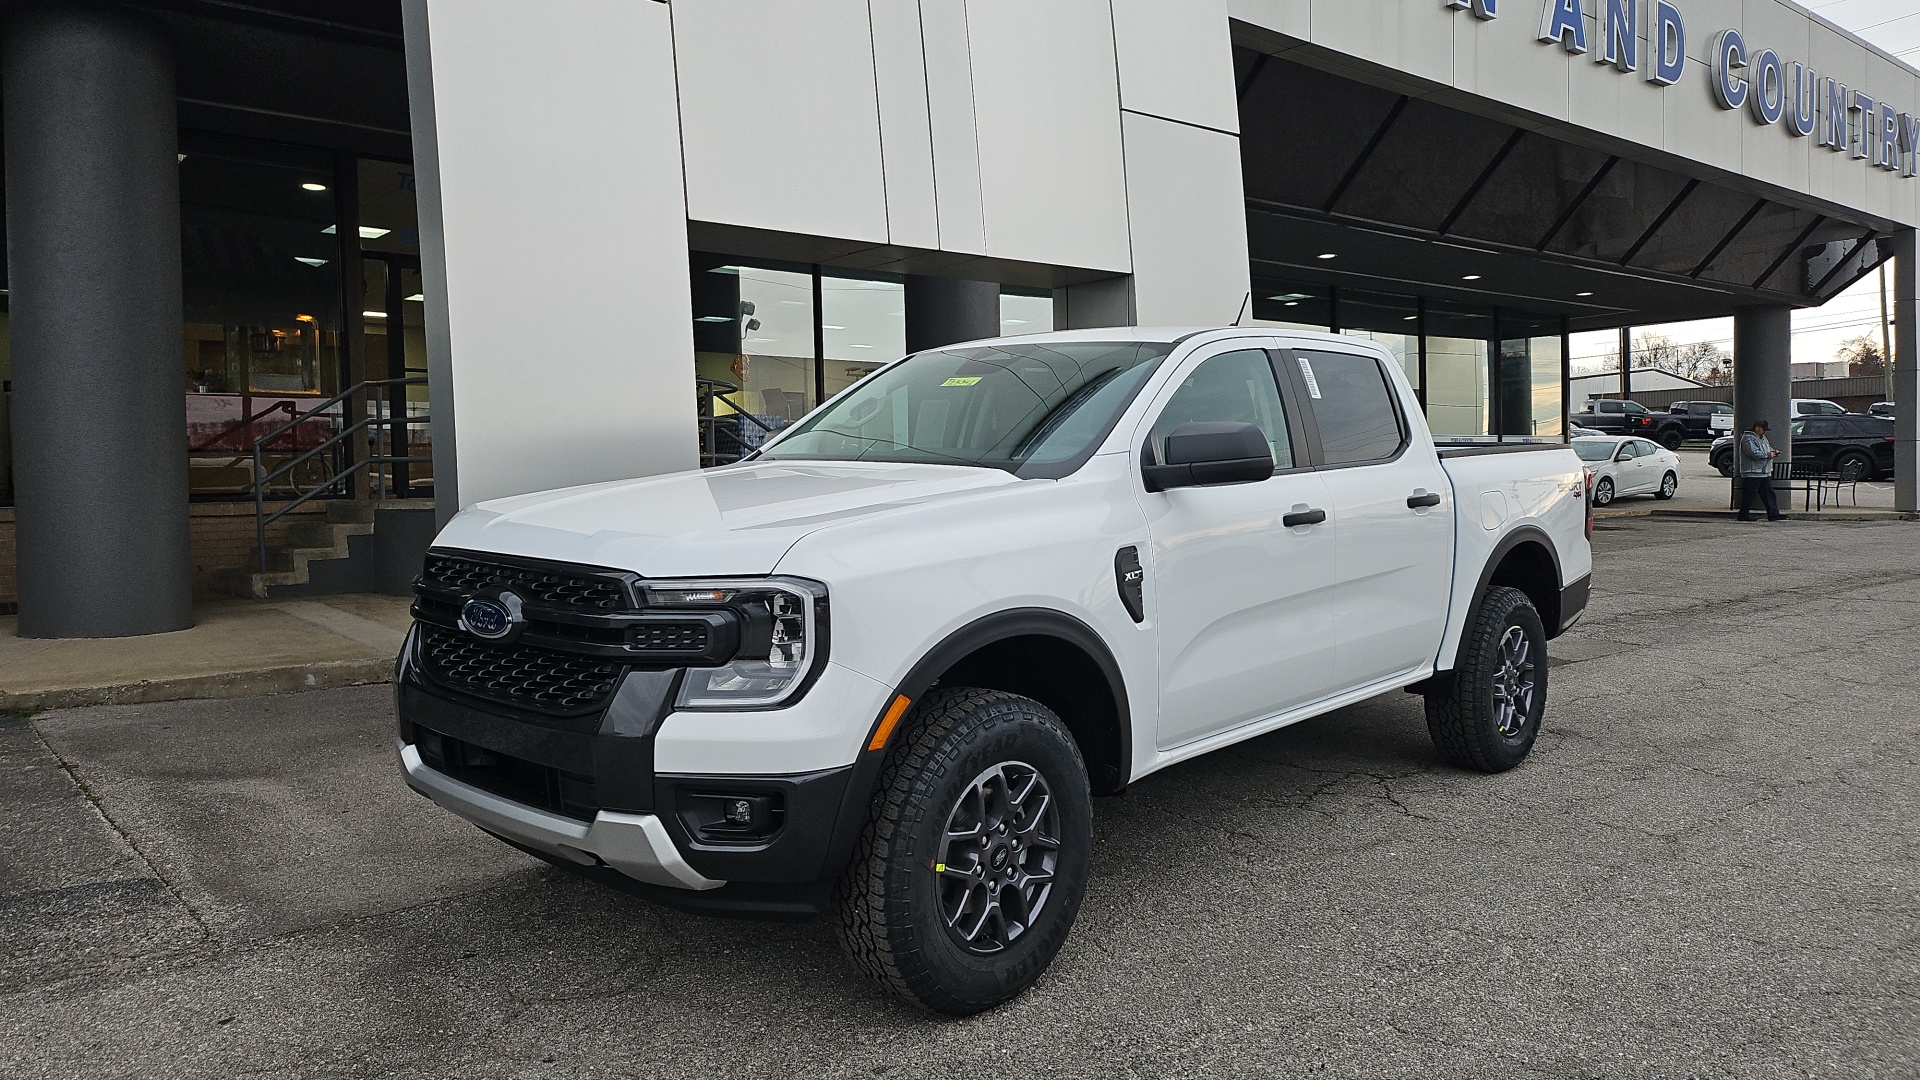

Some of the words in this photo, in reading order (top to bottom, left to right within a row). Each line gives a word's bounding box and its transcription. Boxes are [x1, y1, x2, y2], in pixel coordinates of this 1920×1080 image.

[1538, 0, 1685, 86] AND
[1711, 28, 1920, 178] COUNTRY
[1124, 570, 1142, 582] XLT
[470, 605, 498, 630] Ford
